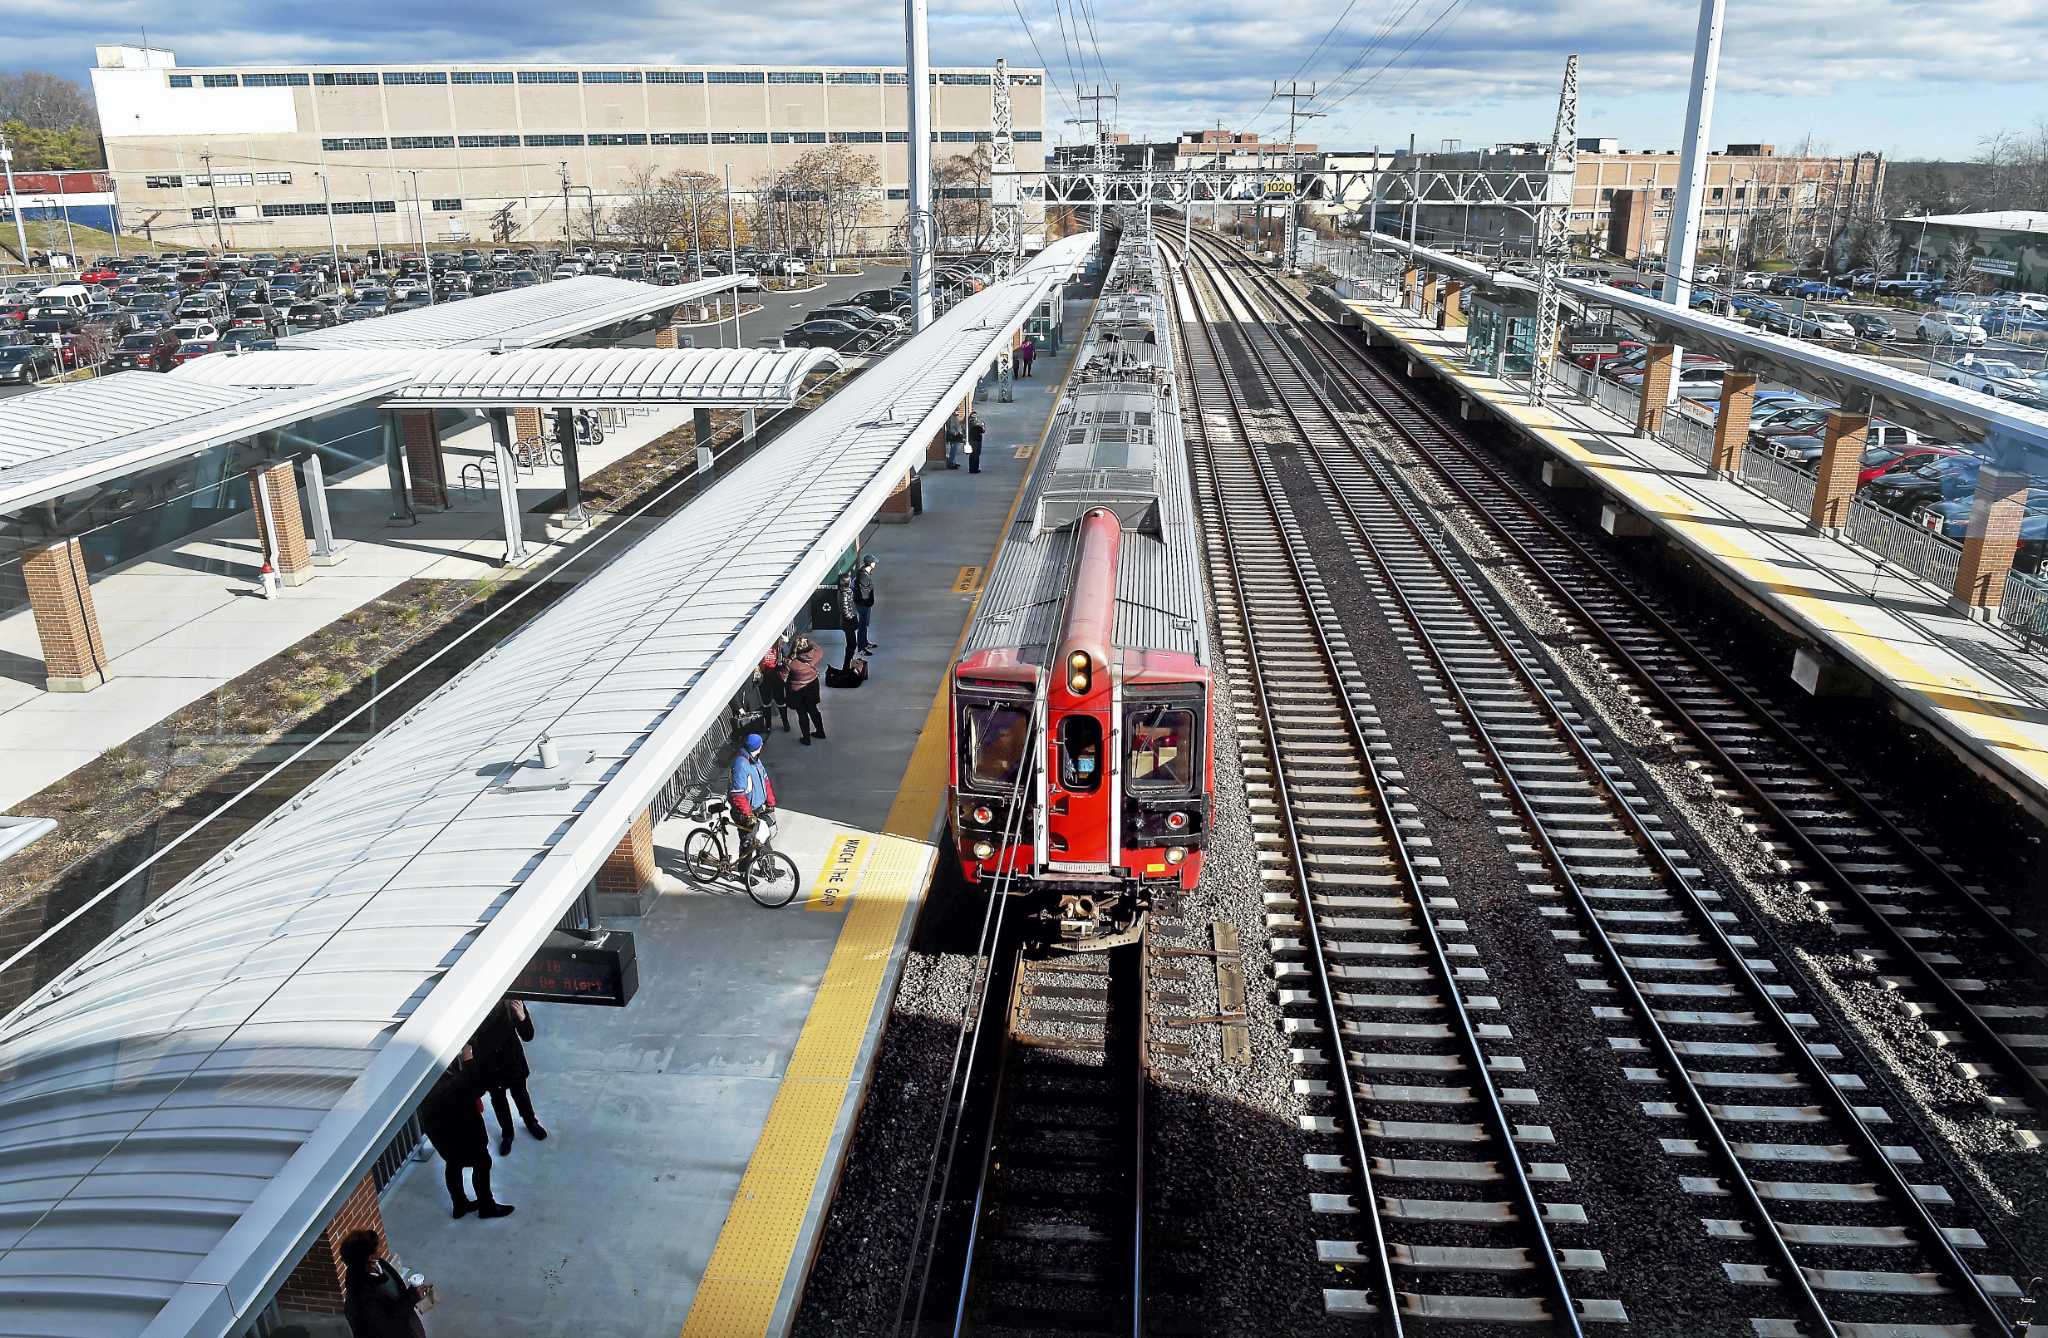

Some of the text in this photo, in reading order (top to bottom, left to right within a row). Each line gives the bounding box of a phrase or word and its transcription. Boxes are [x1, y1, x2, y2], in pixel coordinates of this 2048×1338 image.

[1267, 182, 1292, 192] 1020
[819, 839, 860, 906] WATCH THE GAP
